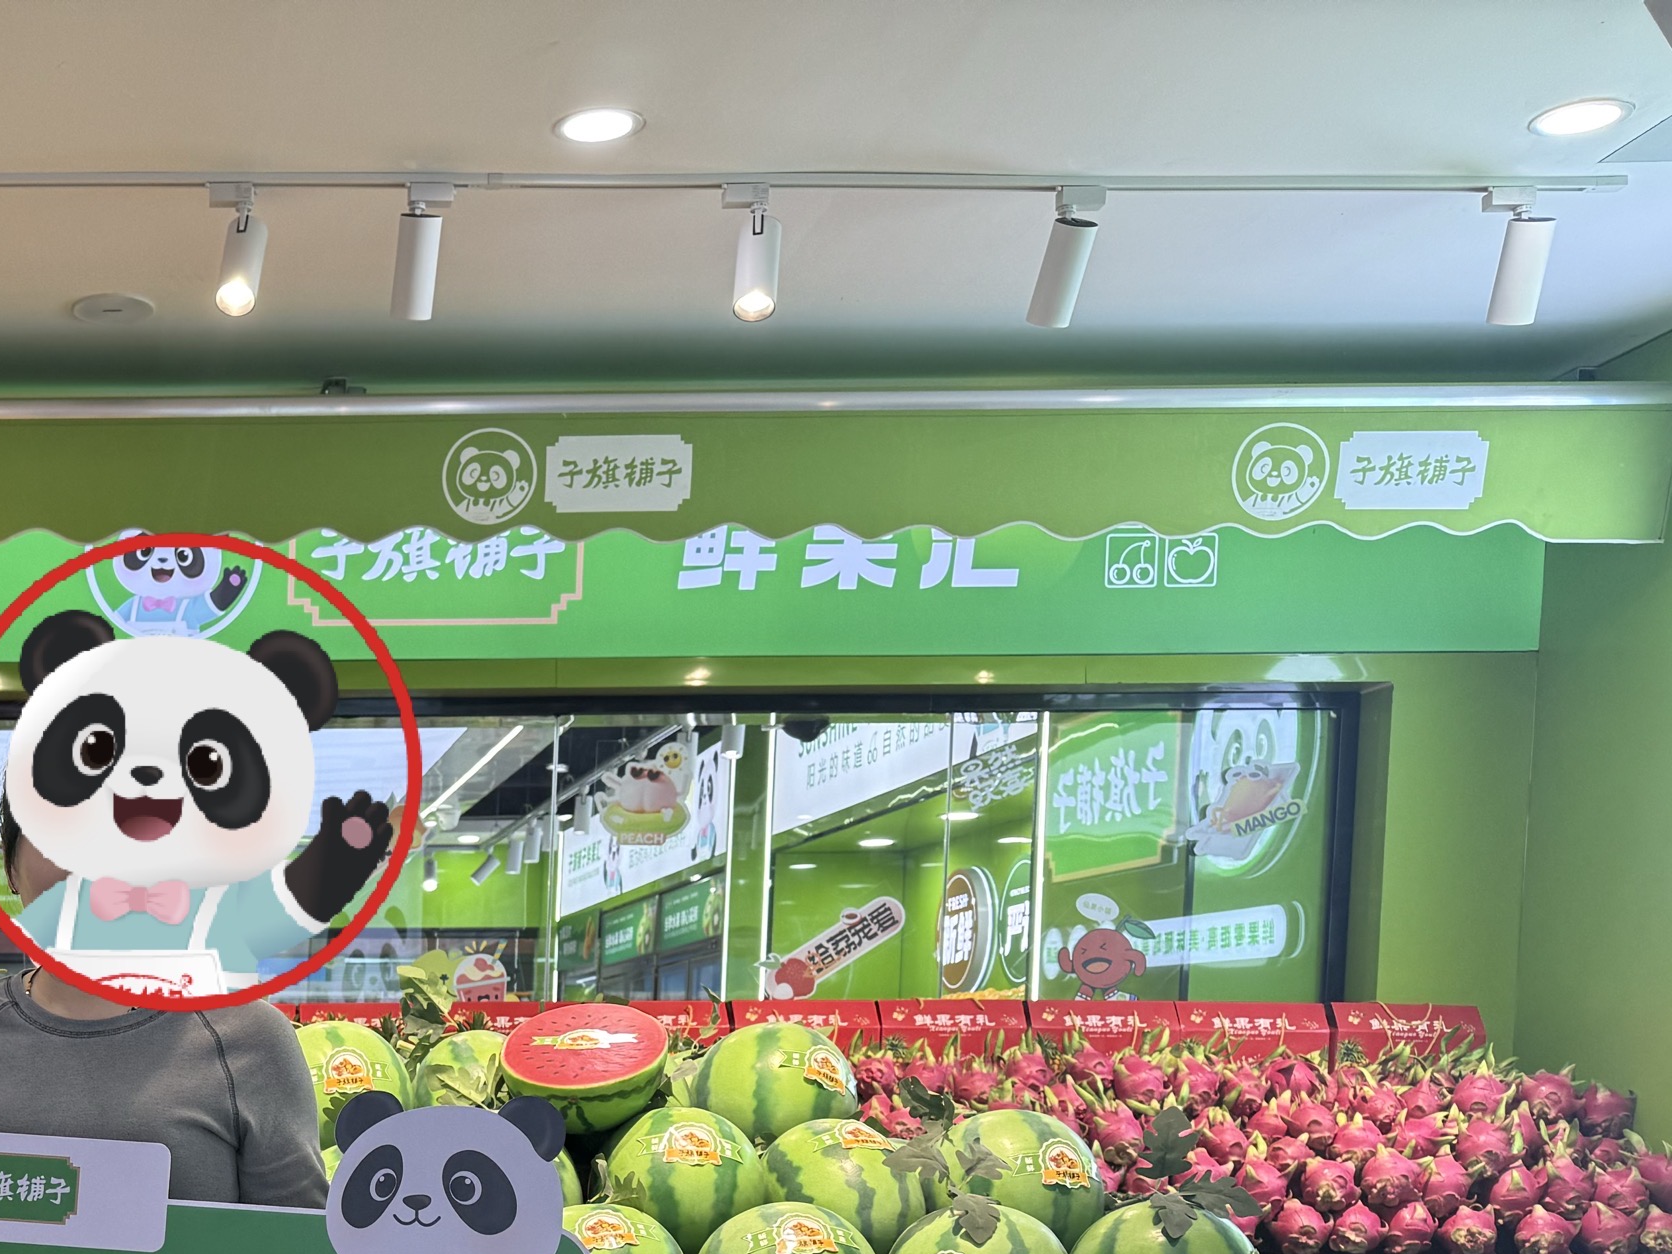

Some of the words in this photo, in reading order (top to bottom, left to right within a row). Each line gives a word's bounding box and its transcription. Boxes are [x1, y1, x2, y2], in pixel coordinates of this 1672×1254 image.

[558, 455, 682, 490] 子旗铺子
[1350, 454, 1477, 487] 子旗铺子
[311, 525, 566, 582] 子旗铺子
[1234, 801, 1301, 838] MANGO
[620, 834, 665, 845] PEACH
